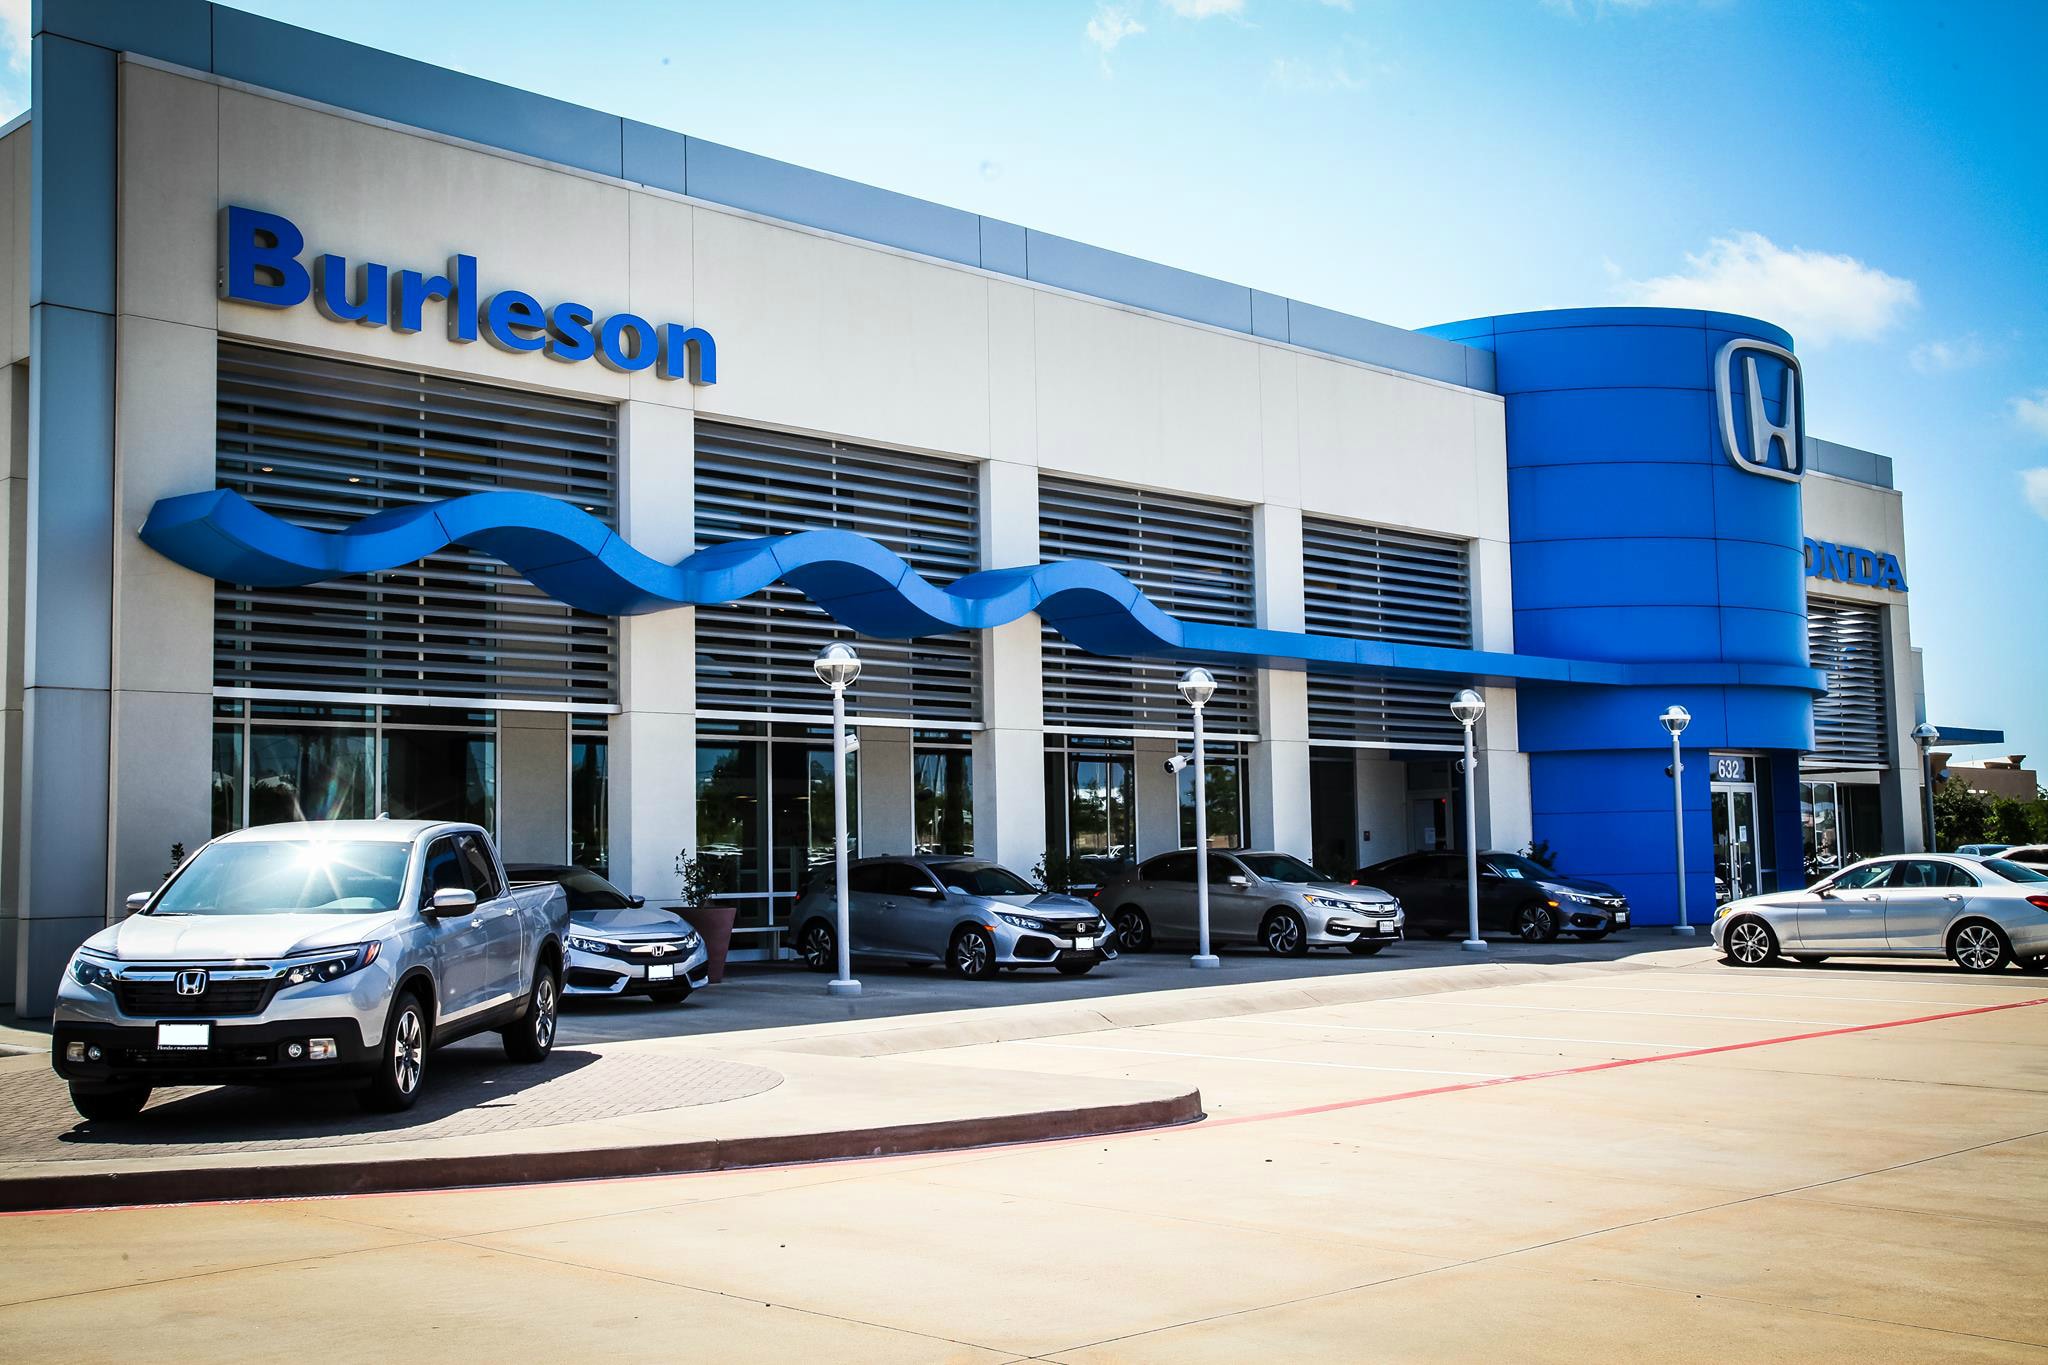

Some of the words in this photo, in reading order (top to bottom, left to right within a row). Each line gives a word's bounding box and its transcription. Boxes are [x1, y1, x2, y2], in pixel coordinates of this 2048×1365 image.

[218, 205, 718, 386] Burleson
[1804, 536, 1908, 593] ONDA
[1718, 759, 1740, 779] 632
